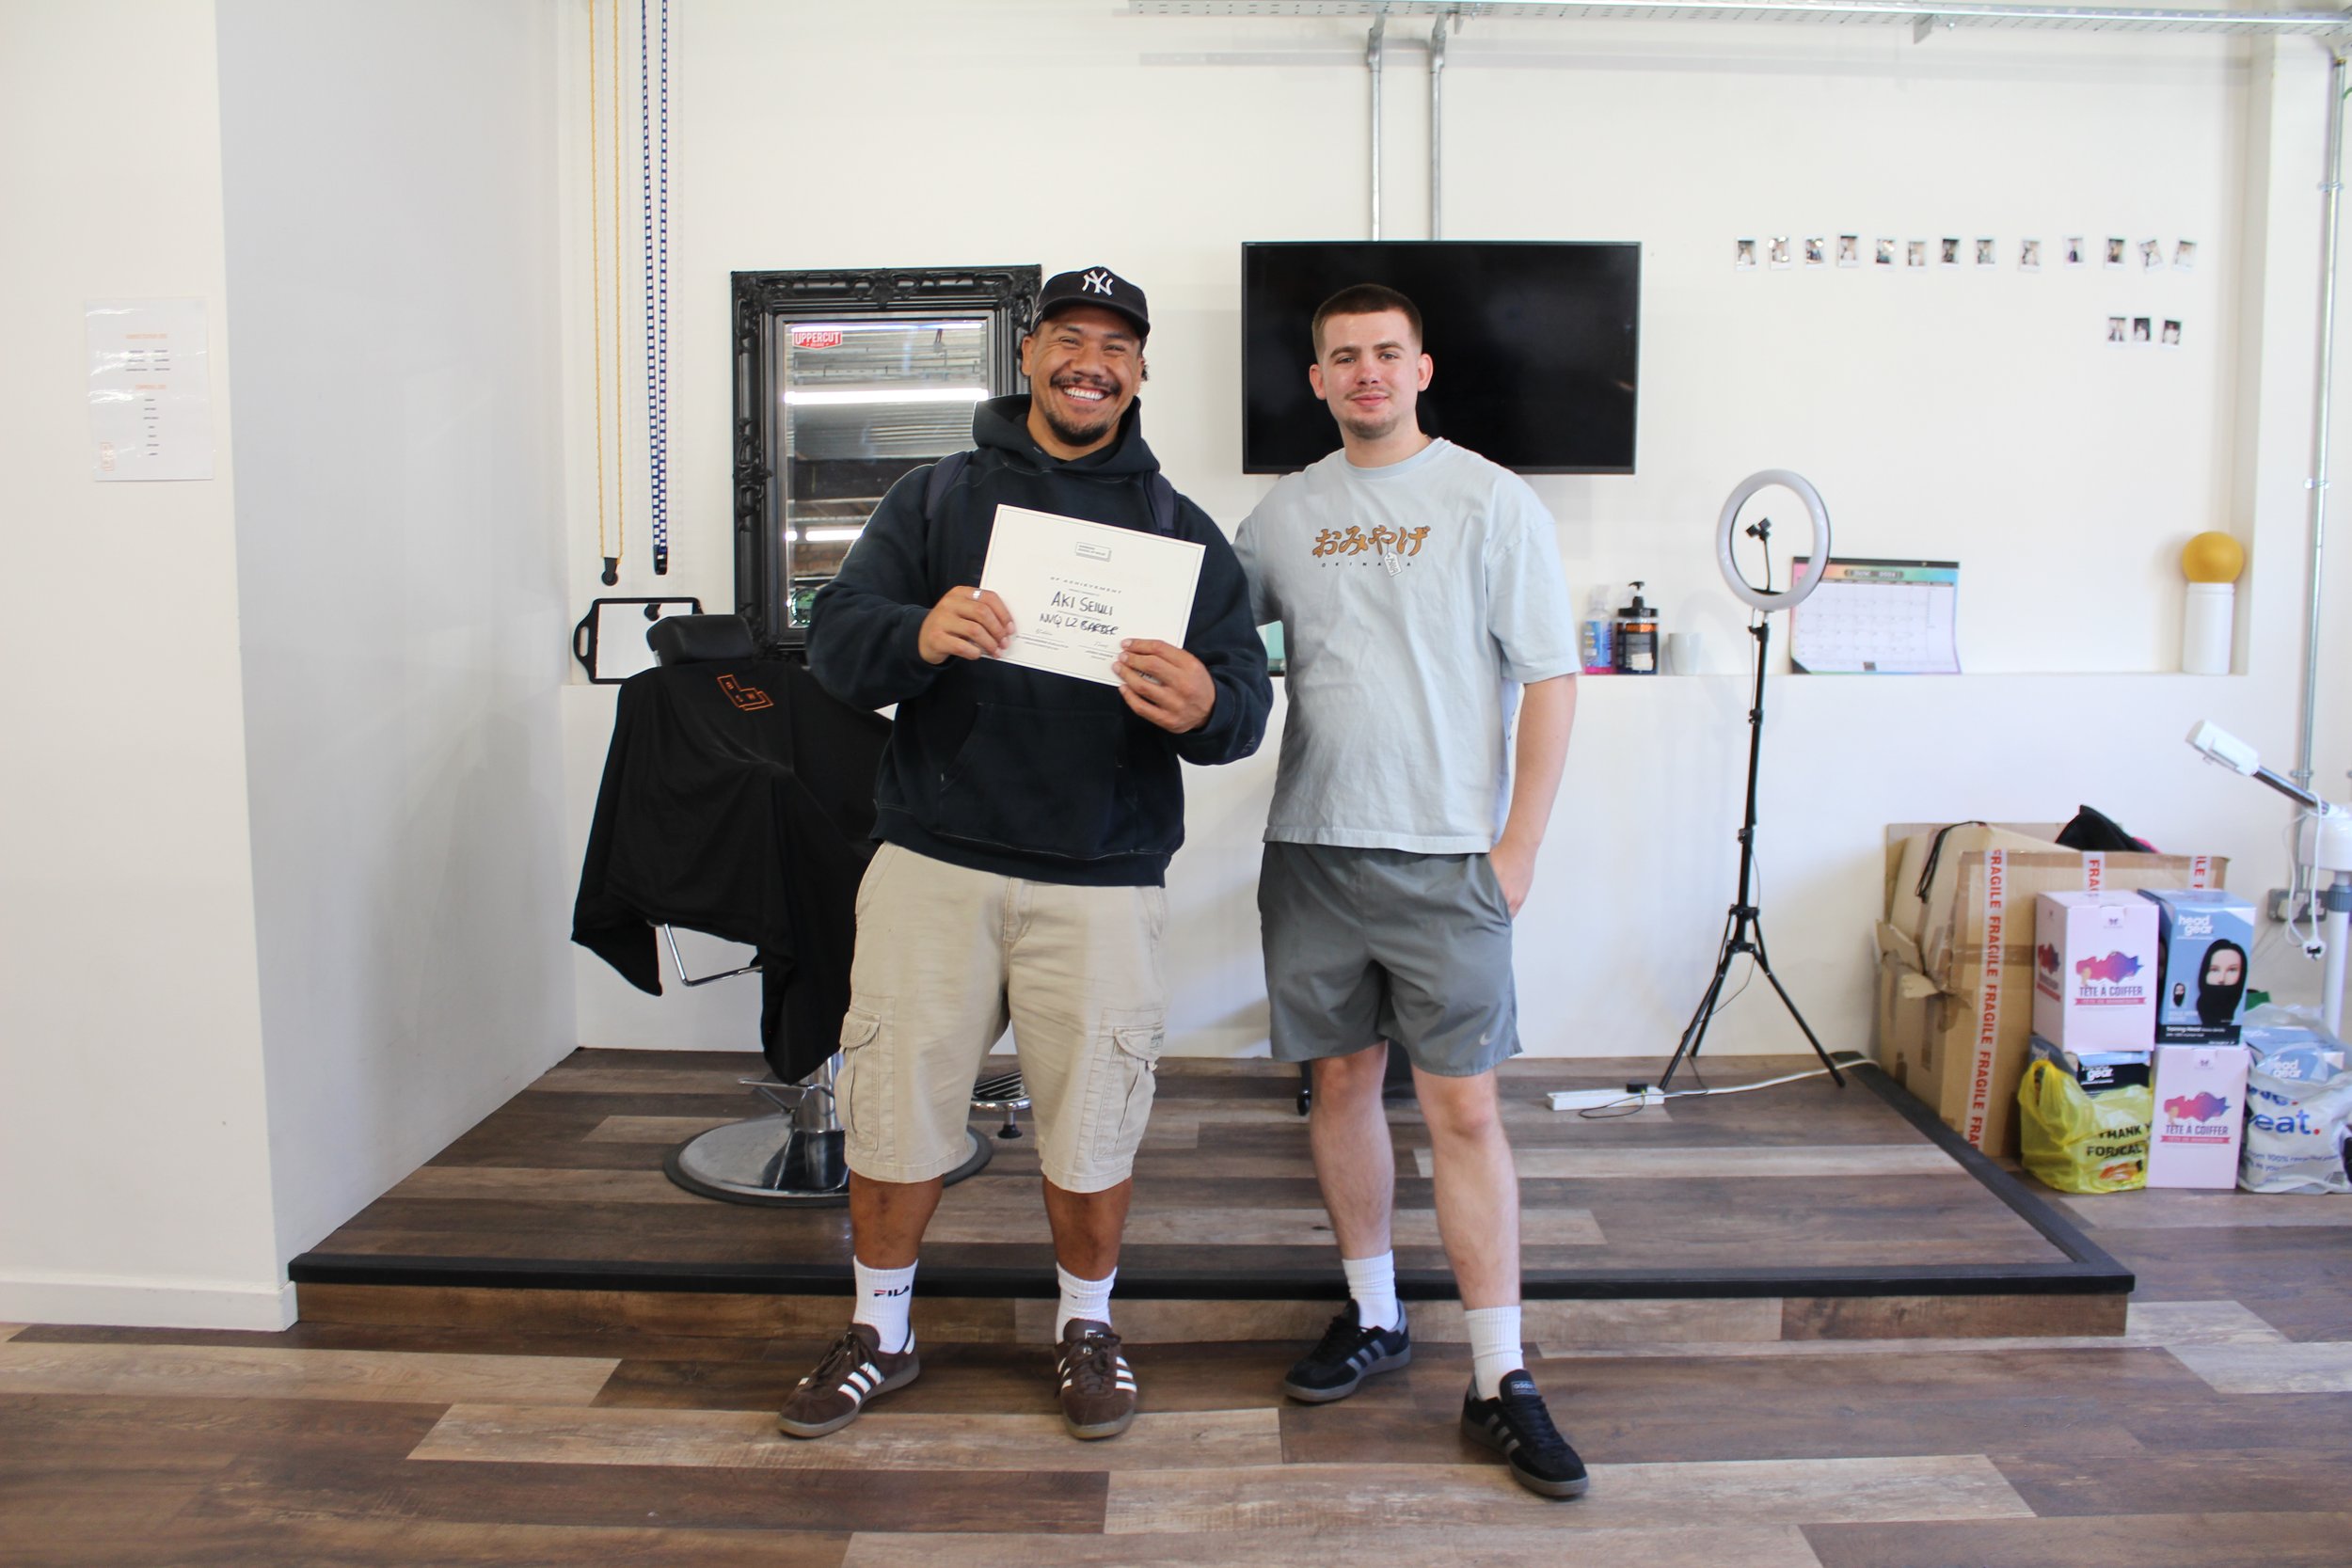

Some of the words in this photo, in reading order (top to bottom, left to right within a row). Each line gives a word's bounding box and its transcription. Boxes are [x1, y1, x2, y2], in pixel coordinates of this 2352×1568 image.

[1082, 270, 1114, 296] NY
[795, 332, 840, 345] UPPERCUT
[1312, 525, 1431, 558] おみやげ
[1050, 591, 1076, 609] AKI
[1040, 612, 1063, 628] NVQ
[1989, 848, 2003, 909] FRAGILE
[2178, 914, 2211, 926] head
[2184, 925, 2214, 937] gear
[1986, 916, 2001, 977] FRAGILE
[2108, 986, 2143, 996] COIFFER
[1980, 984, 1997, 1045] FRAGILE
[1972, 1052, 1992, 1110] FRAGILE
[2195, 1125, 2229, 1135] COIFFER
[873, 1285, 910, 1297] FILA
